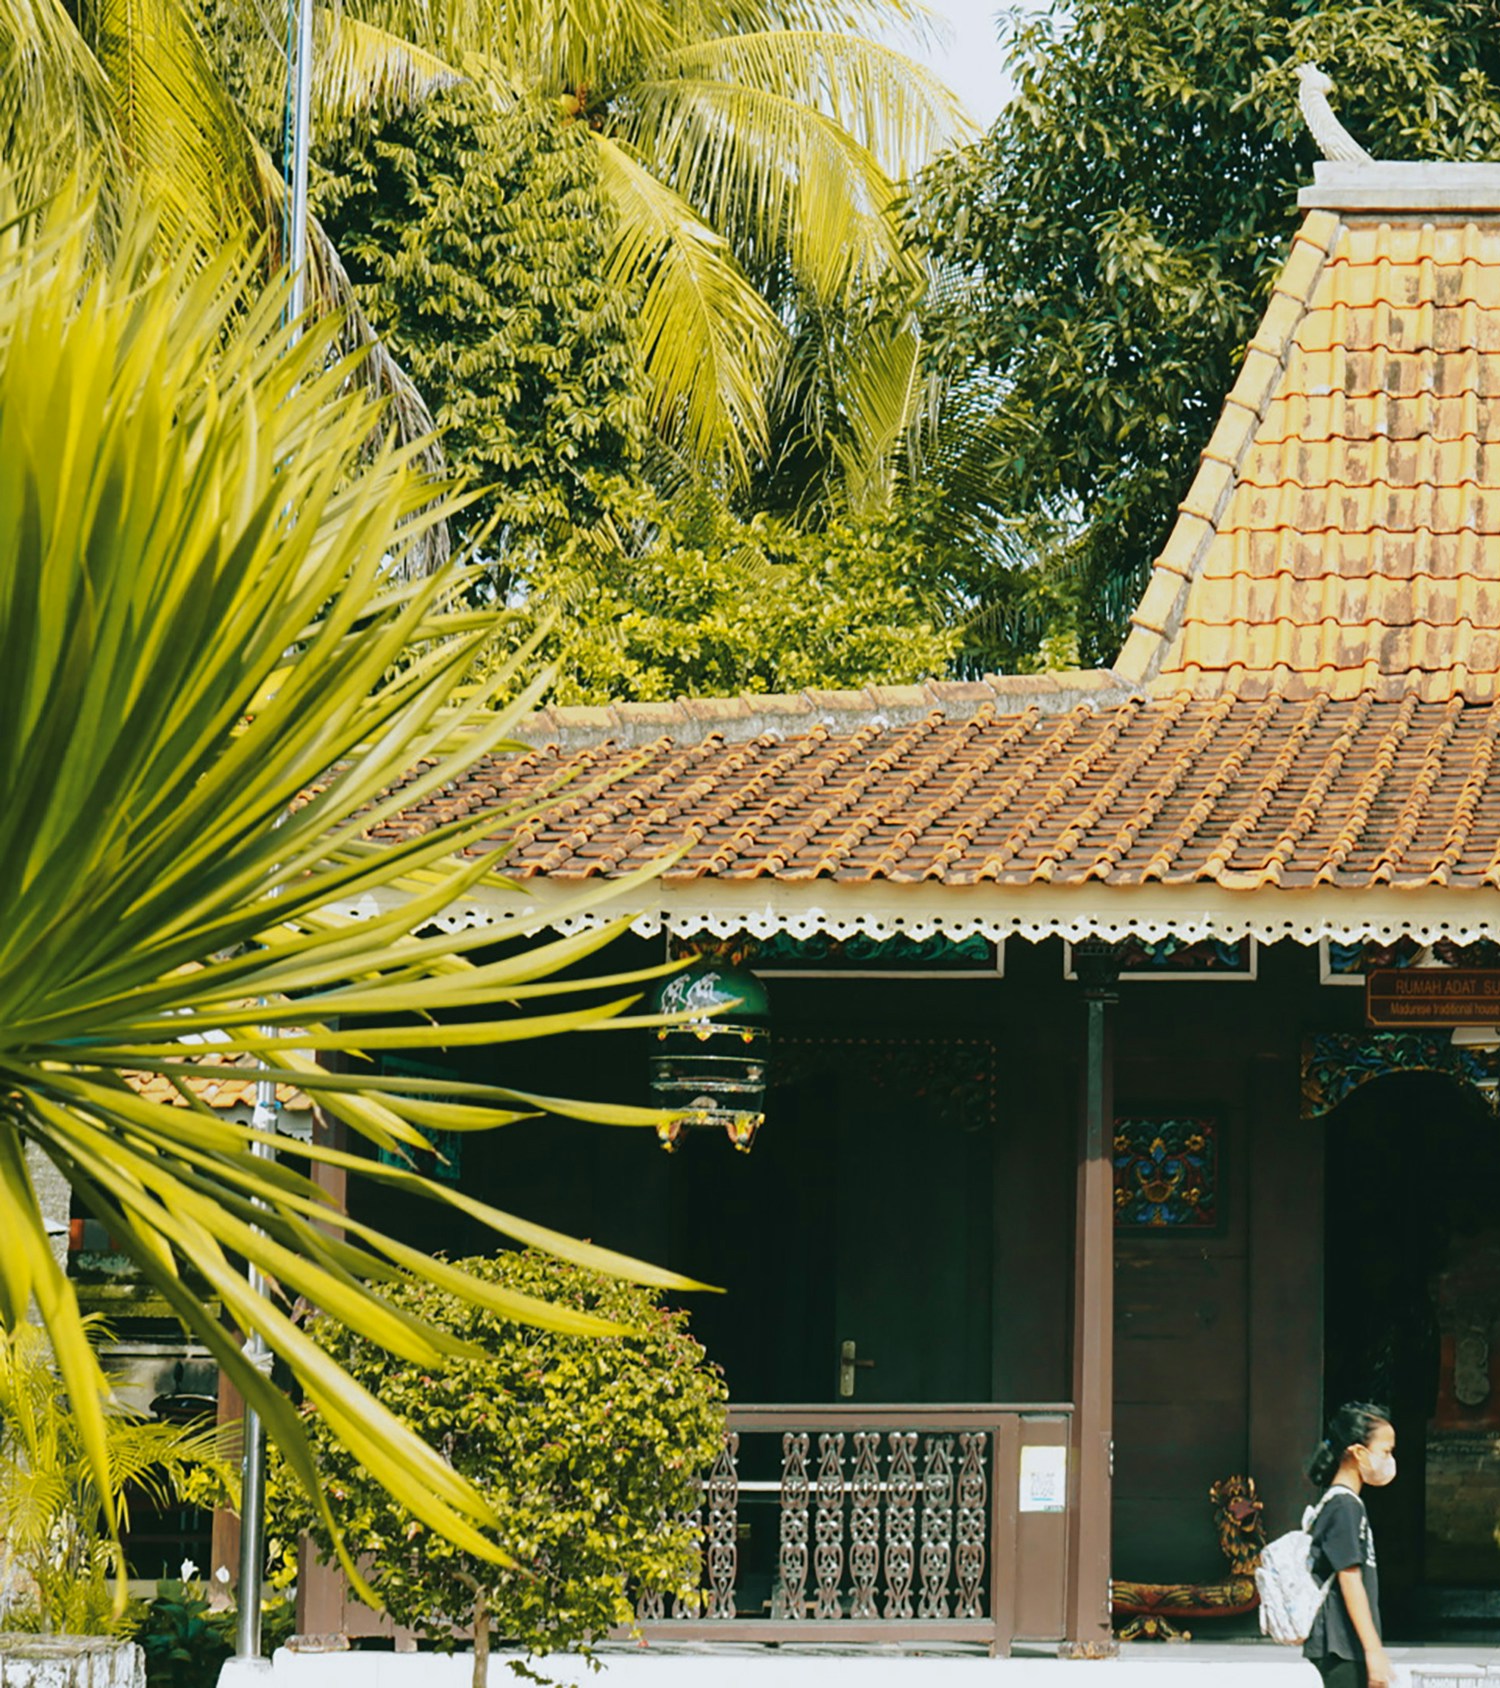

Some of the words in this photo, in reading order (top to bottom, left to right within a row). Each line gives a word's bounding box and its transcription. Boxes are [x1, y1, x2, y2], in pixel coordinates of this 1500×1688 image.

[1395, 978, 1442, 995] RUMAH
[1443, 978, 1477, 995] ADAT
[1390, 1002, 1432, 1016] Madurese
[1432, 1001, 1474, 1016] traditional
[1474, 1002, 1500, 1016] house
